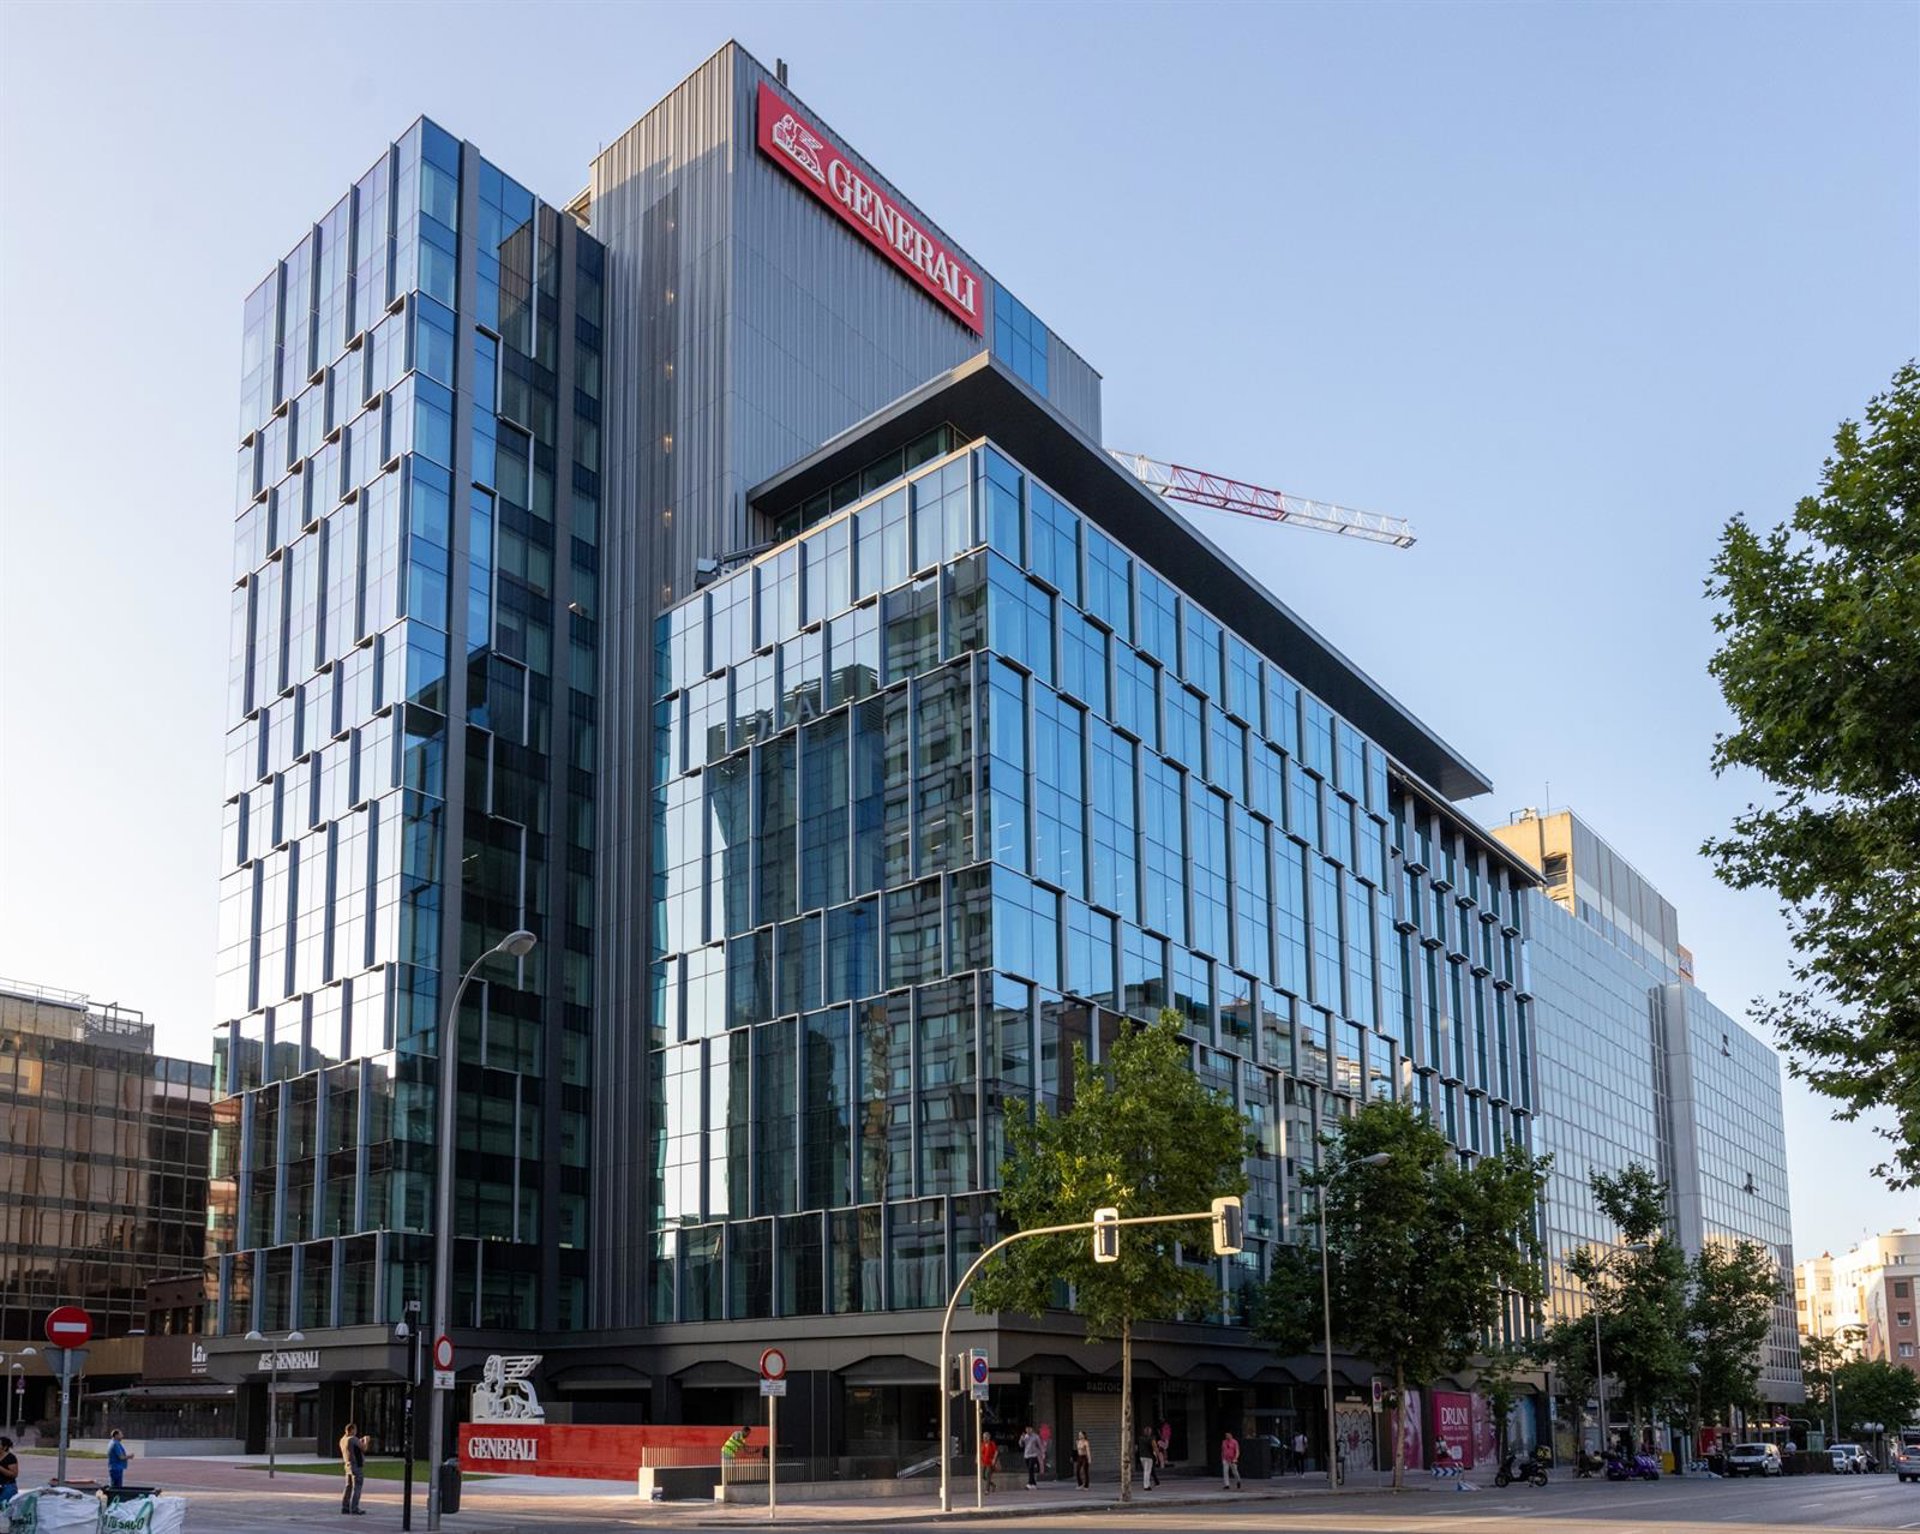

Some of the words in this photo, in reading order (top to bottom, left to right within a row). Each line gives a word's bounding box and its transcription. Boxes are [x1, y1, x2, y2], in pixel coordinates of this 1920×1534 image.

[828, 159, 976, 316] GENERALI
[1441, 1407, 1468, 1425] DRUNI
[468, 1437, 538, 1461] GENERALI
